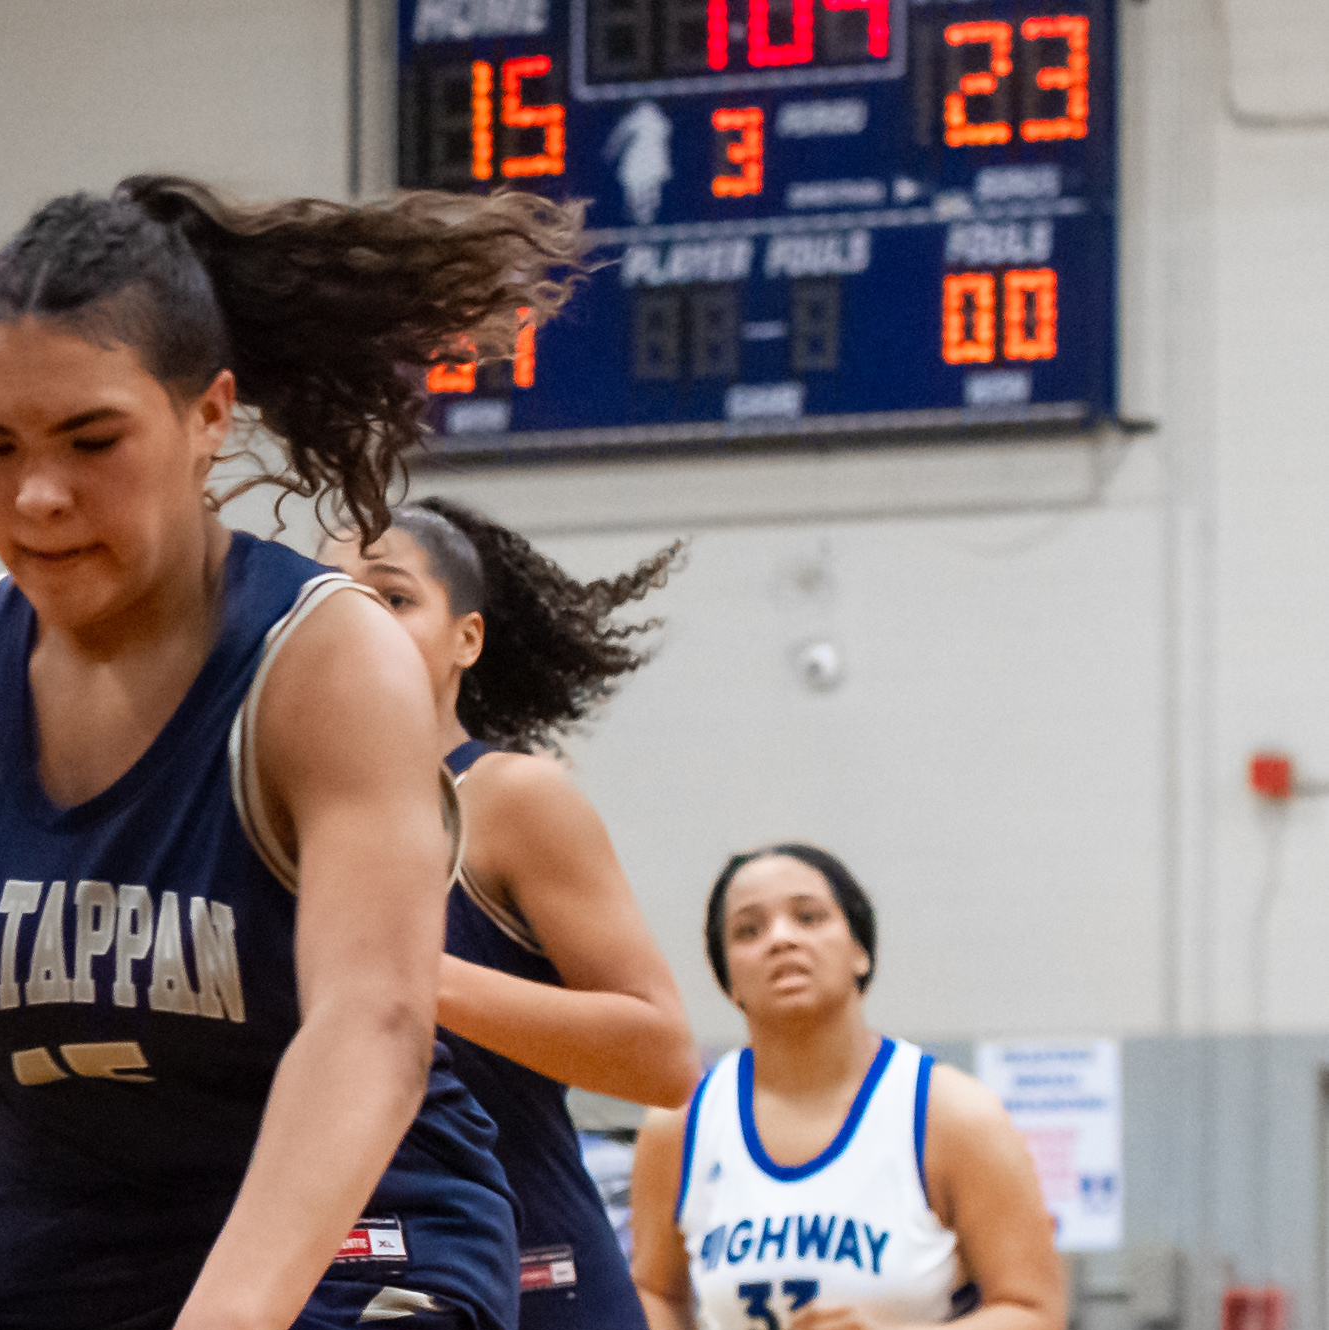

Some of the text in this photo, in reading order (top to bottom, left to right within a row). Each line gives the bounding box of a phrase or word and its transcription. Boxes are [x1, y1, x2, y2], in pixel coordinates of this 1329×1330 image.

[472, 55, 565, 179] 15
[944, 15, 1089, 147] 23
[712, 107, 763, 197] 3
[943, 268, 1058, 365] 00
